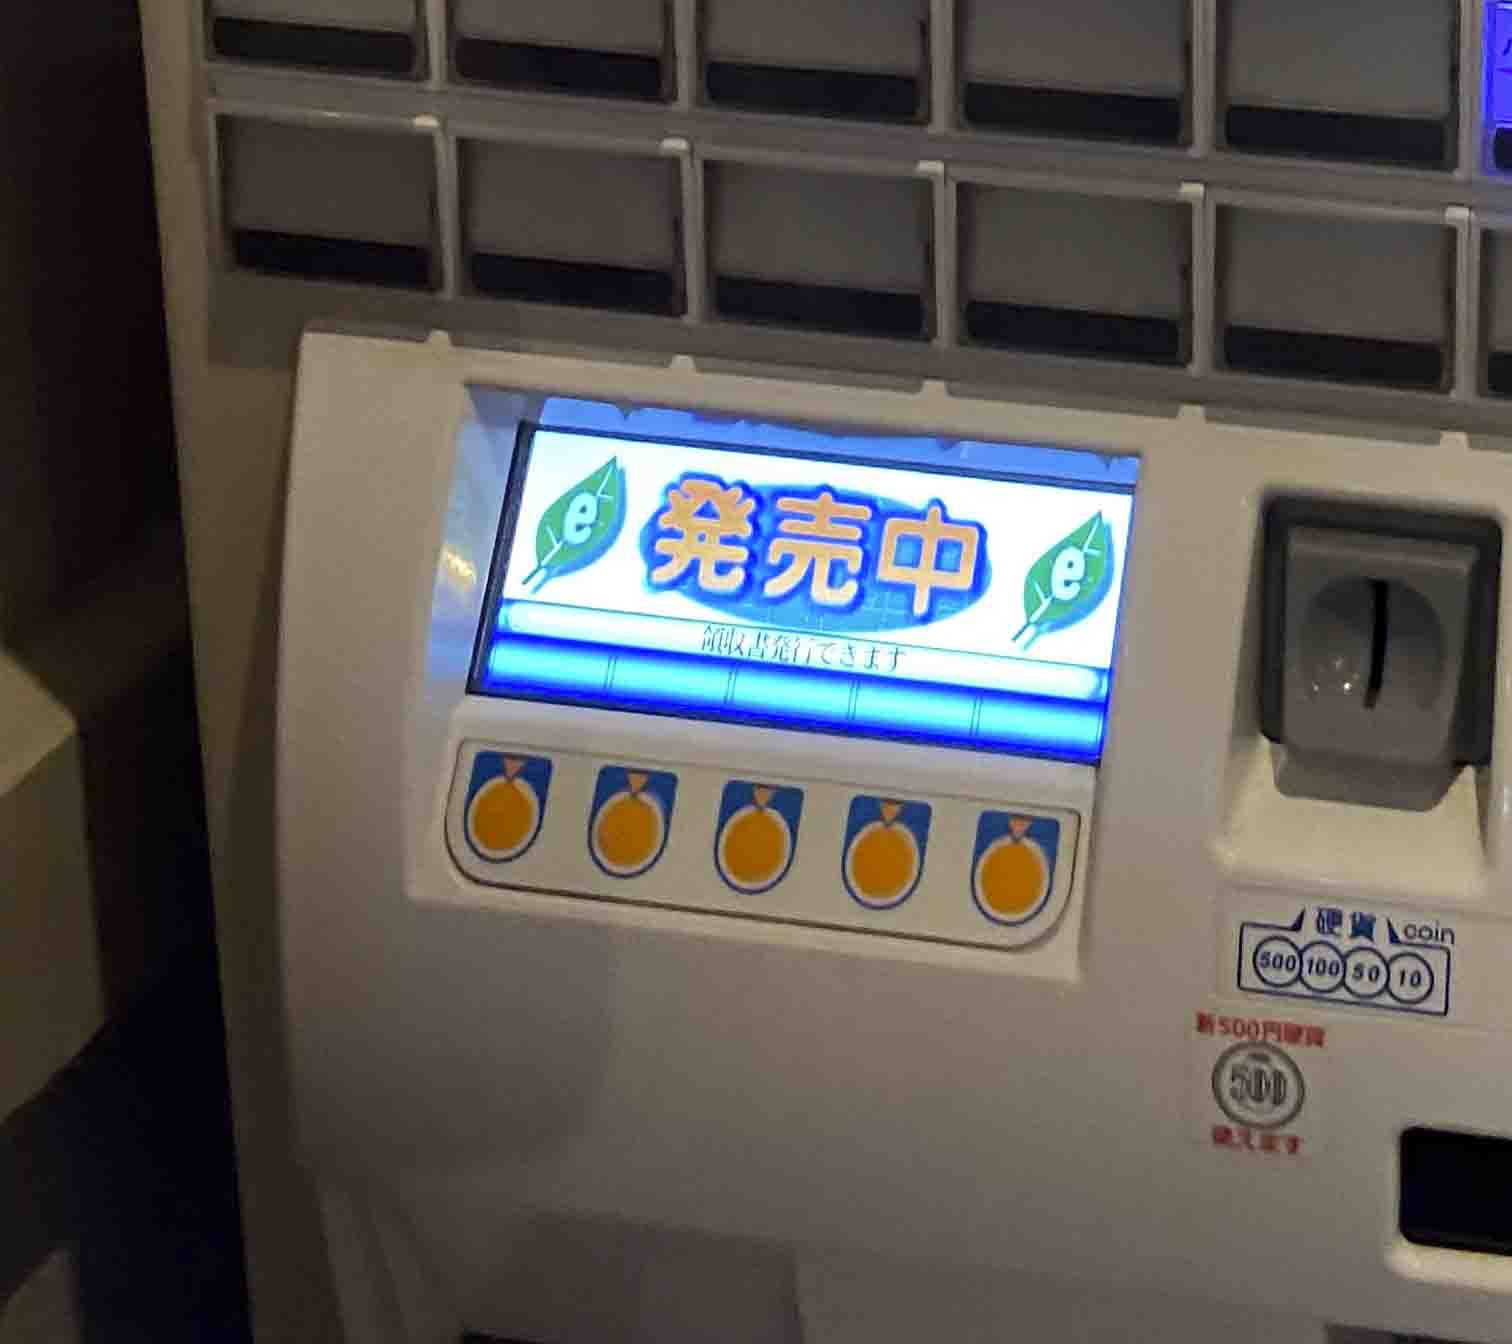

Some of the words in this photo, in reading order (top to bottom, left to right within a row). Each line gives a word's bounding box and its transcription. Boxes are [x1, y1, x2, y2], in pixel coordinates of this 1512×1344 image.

[648, 474, 984, 620] 発売中
[701, 623, 907, 673] 領収書発行できます
[1403, 920, 1456, 946] coin
[1261, 951, 1297, 972] 500
[1307, 958, 1341, 978] 100
[1353, 963, 1381, 983] 50
[1399, 968, 1423, 988] 10
